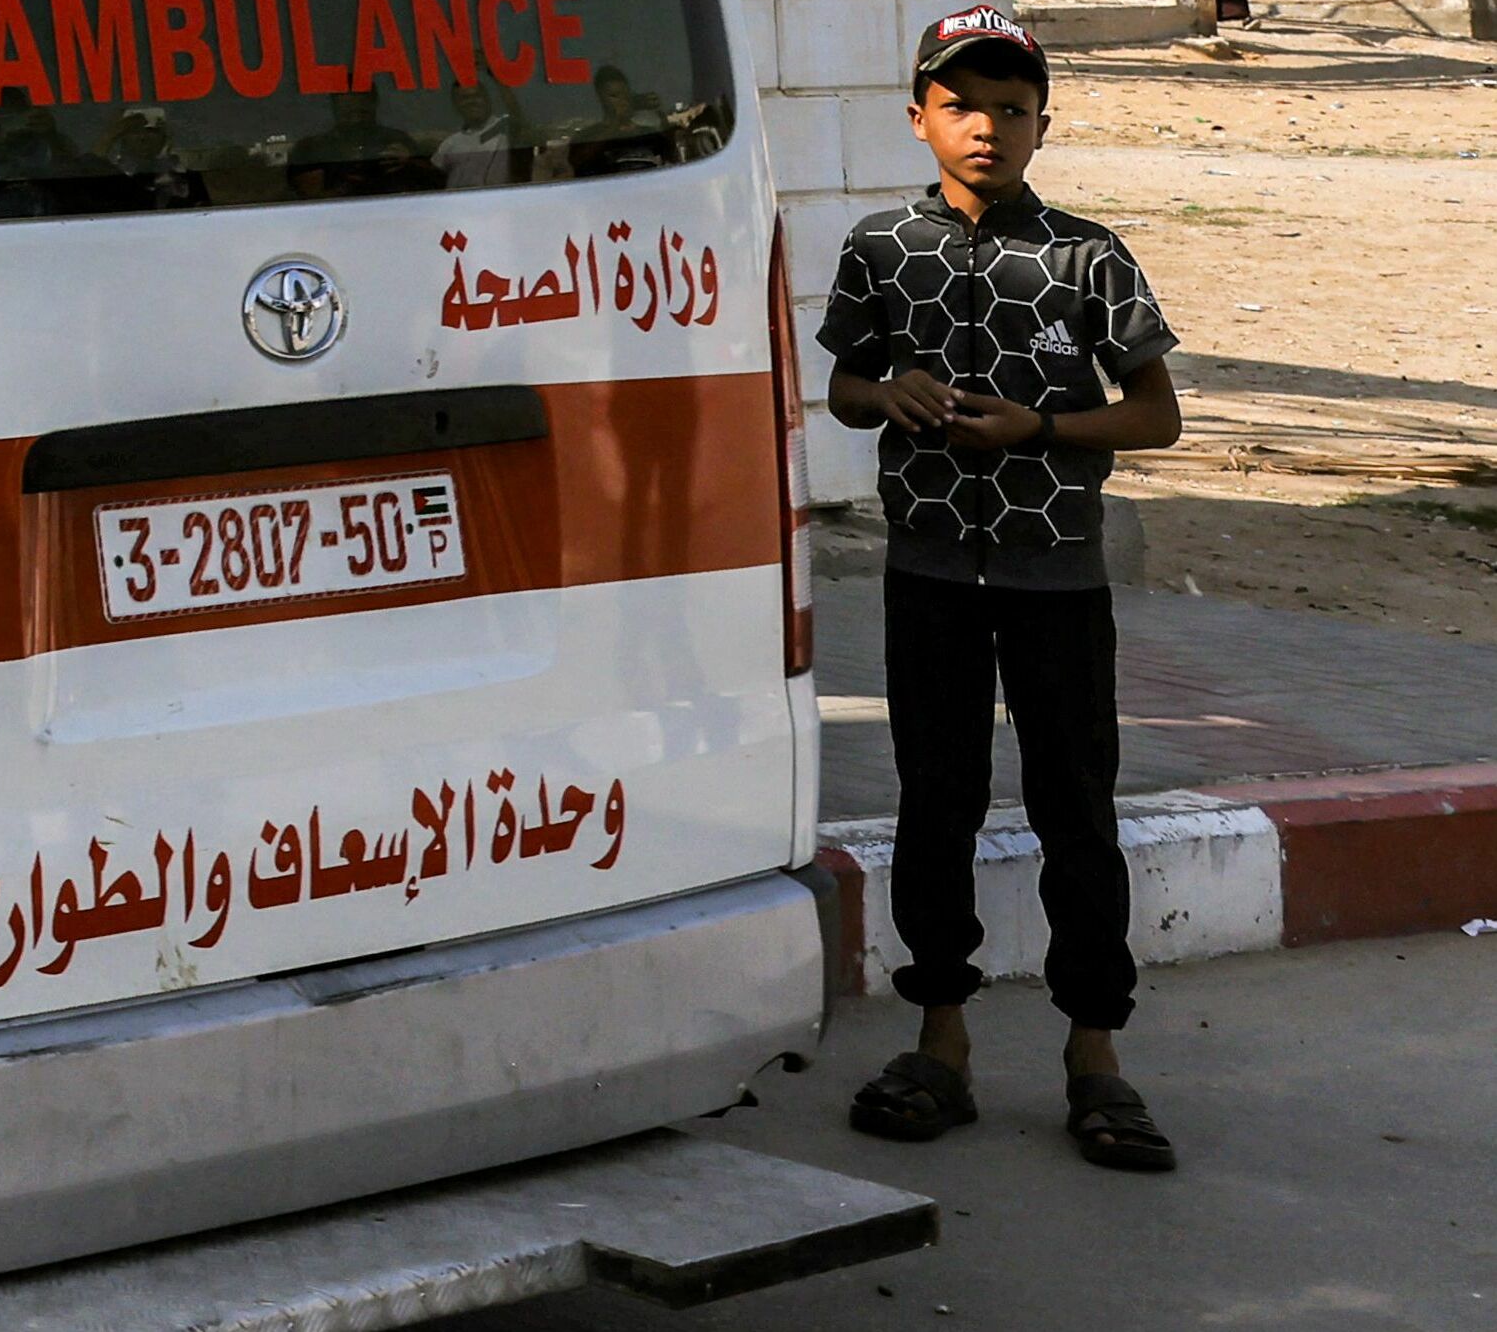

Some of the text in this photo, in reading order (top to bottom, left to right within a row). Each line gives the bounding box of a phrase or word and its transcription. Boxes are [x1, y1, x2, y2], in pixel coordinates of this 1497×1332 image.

[439, 220, 719, 333] وزارة الصحة
[1029, 338, 1079, 357] adidas
[118, 492, 408, 603] 3-2807-50
[247, 777, 475, 909] الإسعاف
[487, 767, 625, 870] وحدة
